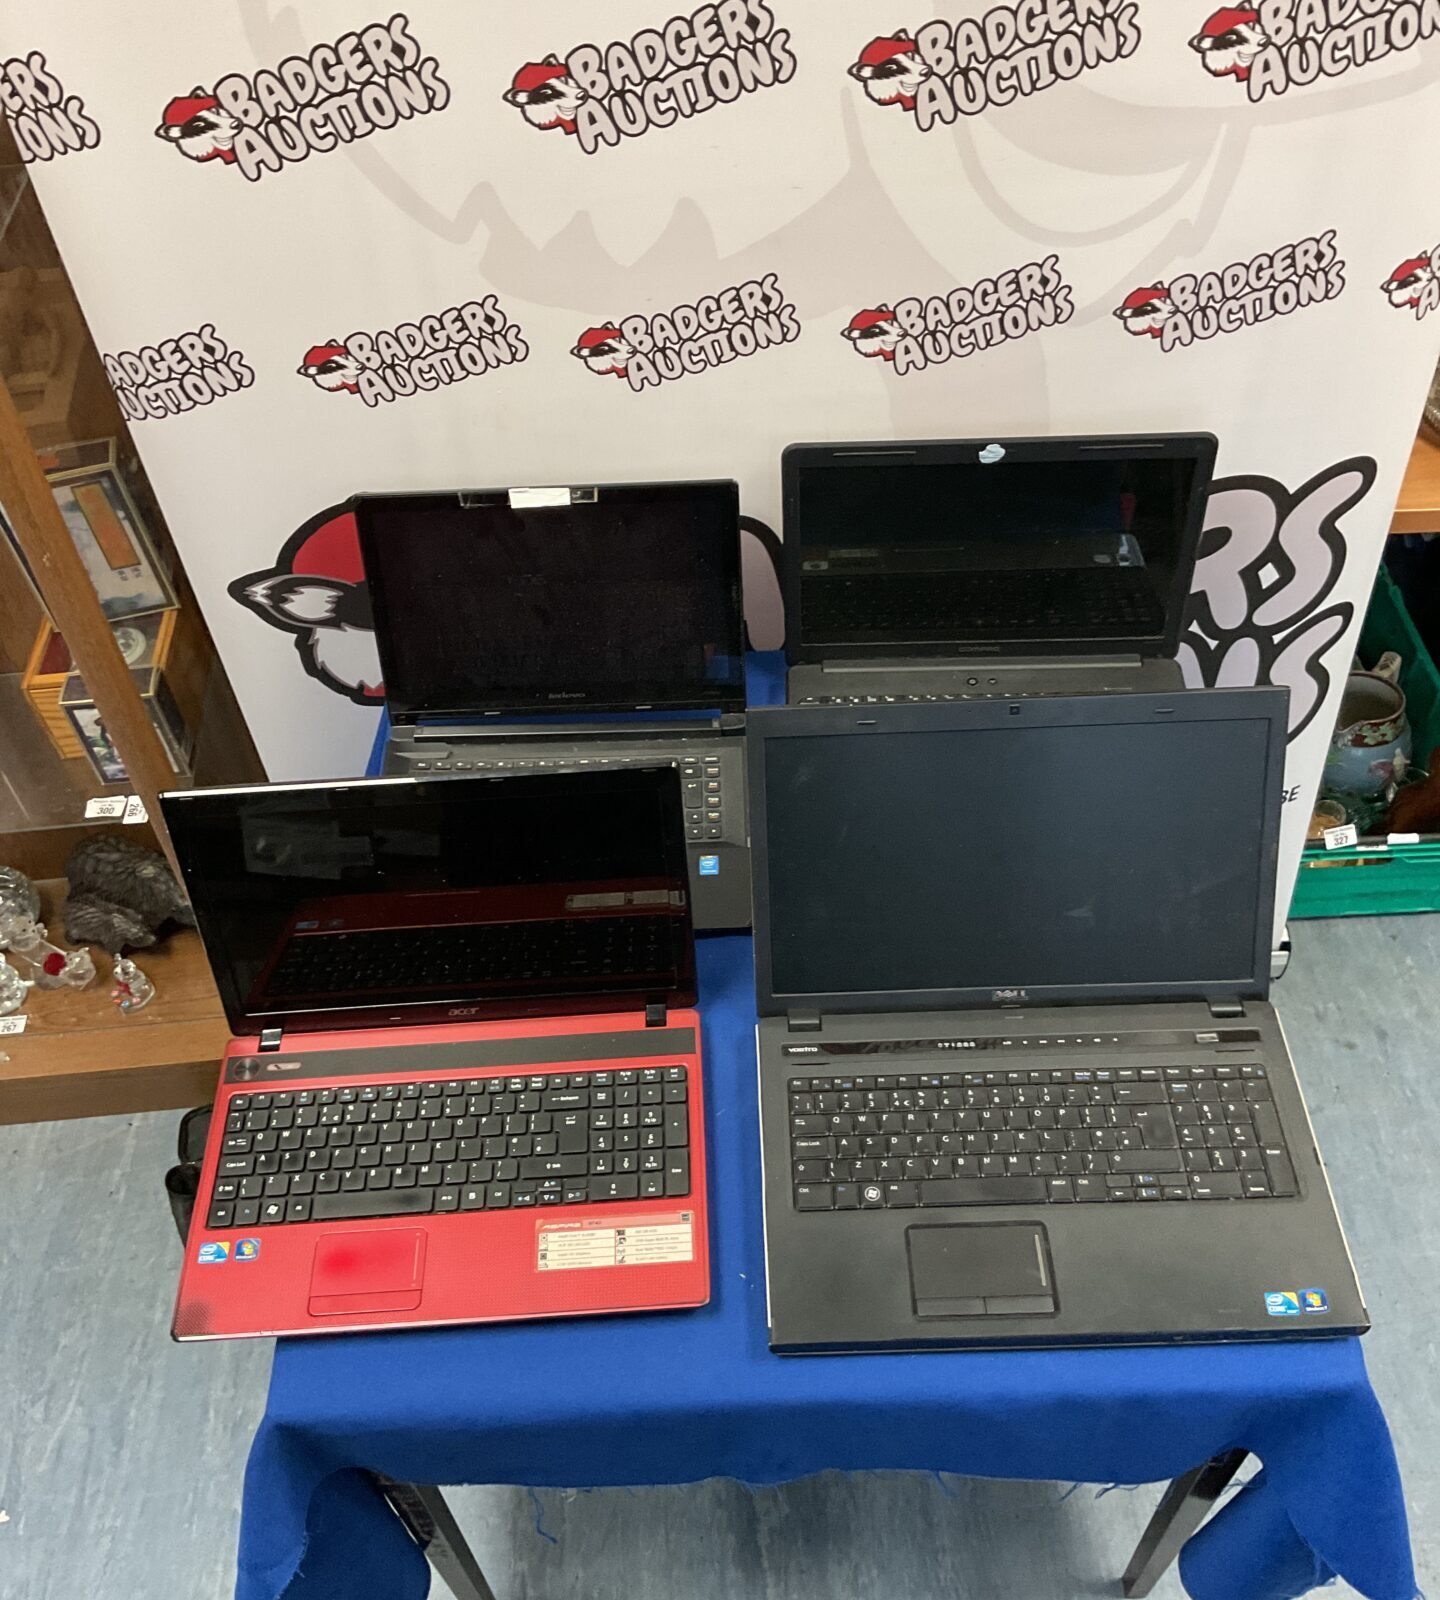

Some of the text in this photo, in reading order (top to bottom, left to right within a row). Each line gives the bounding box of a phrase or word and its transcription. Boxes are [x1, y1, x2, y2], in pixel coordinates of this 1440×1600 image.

[213, 13, 420, 129] BADGERS
[566, 0, 774, 100] BADGERS
[576, 28, 797, 155] AUCTIONS
[914, 2, 1141, 132] AUCTIONS
[233, 56, 450, 182] AUCTIONS
[620, 273, 783, 354] BADGERS
[893, 254, 1061, 338] BADGERS
[1161, 260, 1345, 352] AUCTIONS
[1169, 229, 1337, 314] BADGERS
[103, 323, 227, 391] ADGERS
[344, 294, 507, 371] BADGERS
[357, 324, 529, 407] AUCTIONS
[627, 304, 801, 392] AUCTIONS
[894, 285, 1074, 376] AUCTIONS
[1334, 835, 1349, 846] 327
[448, 1006, 480, 1016] acer
